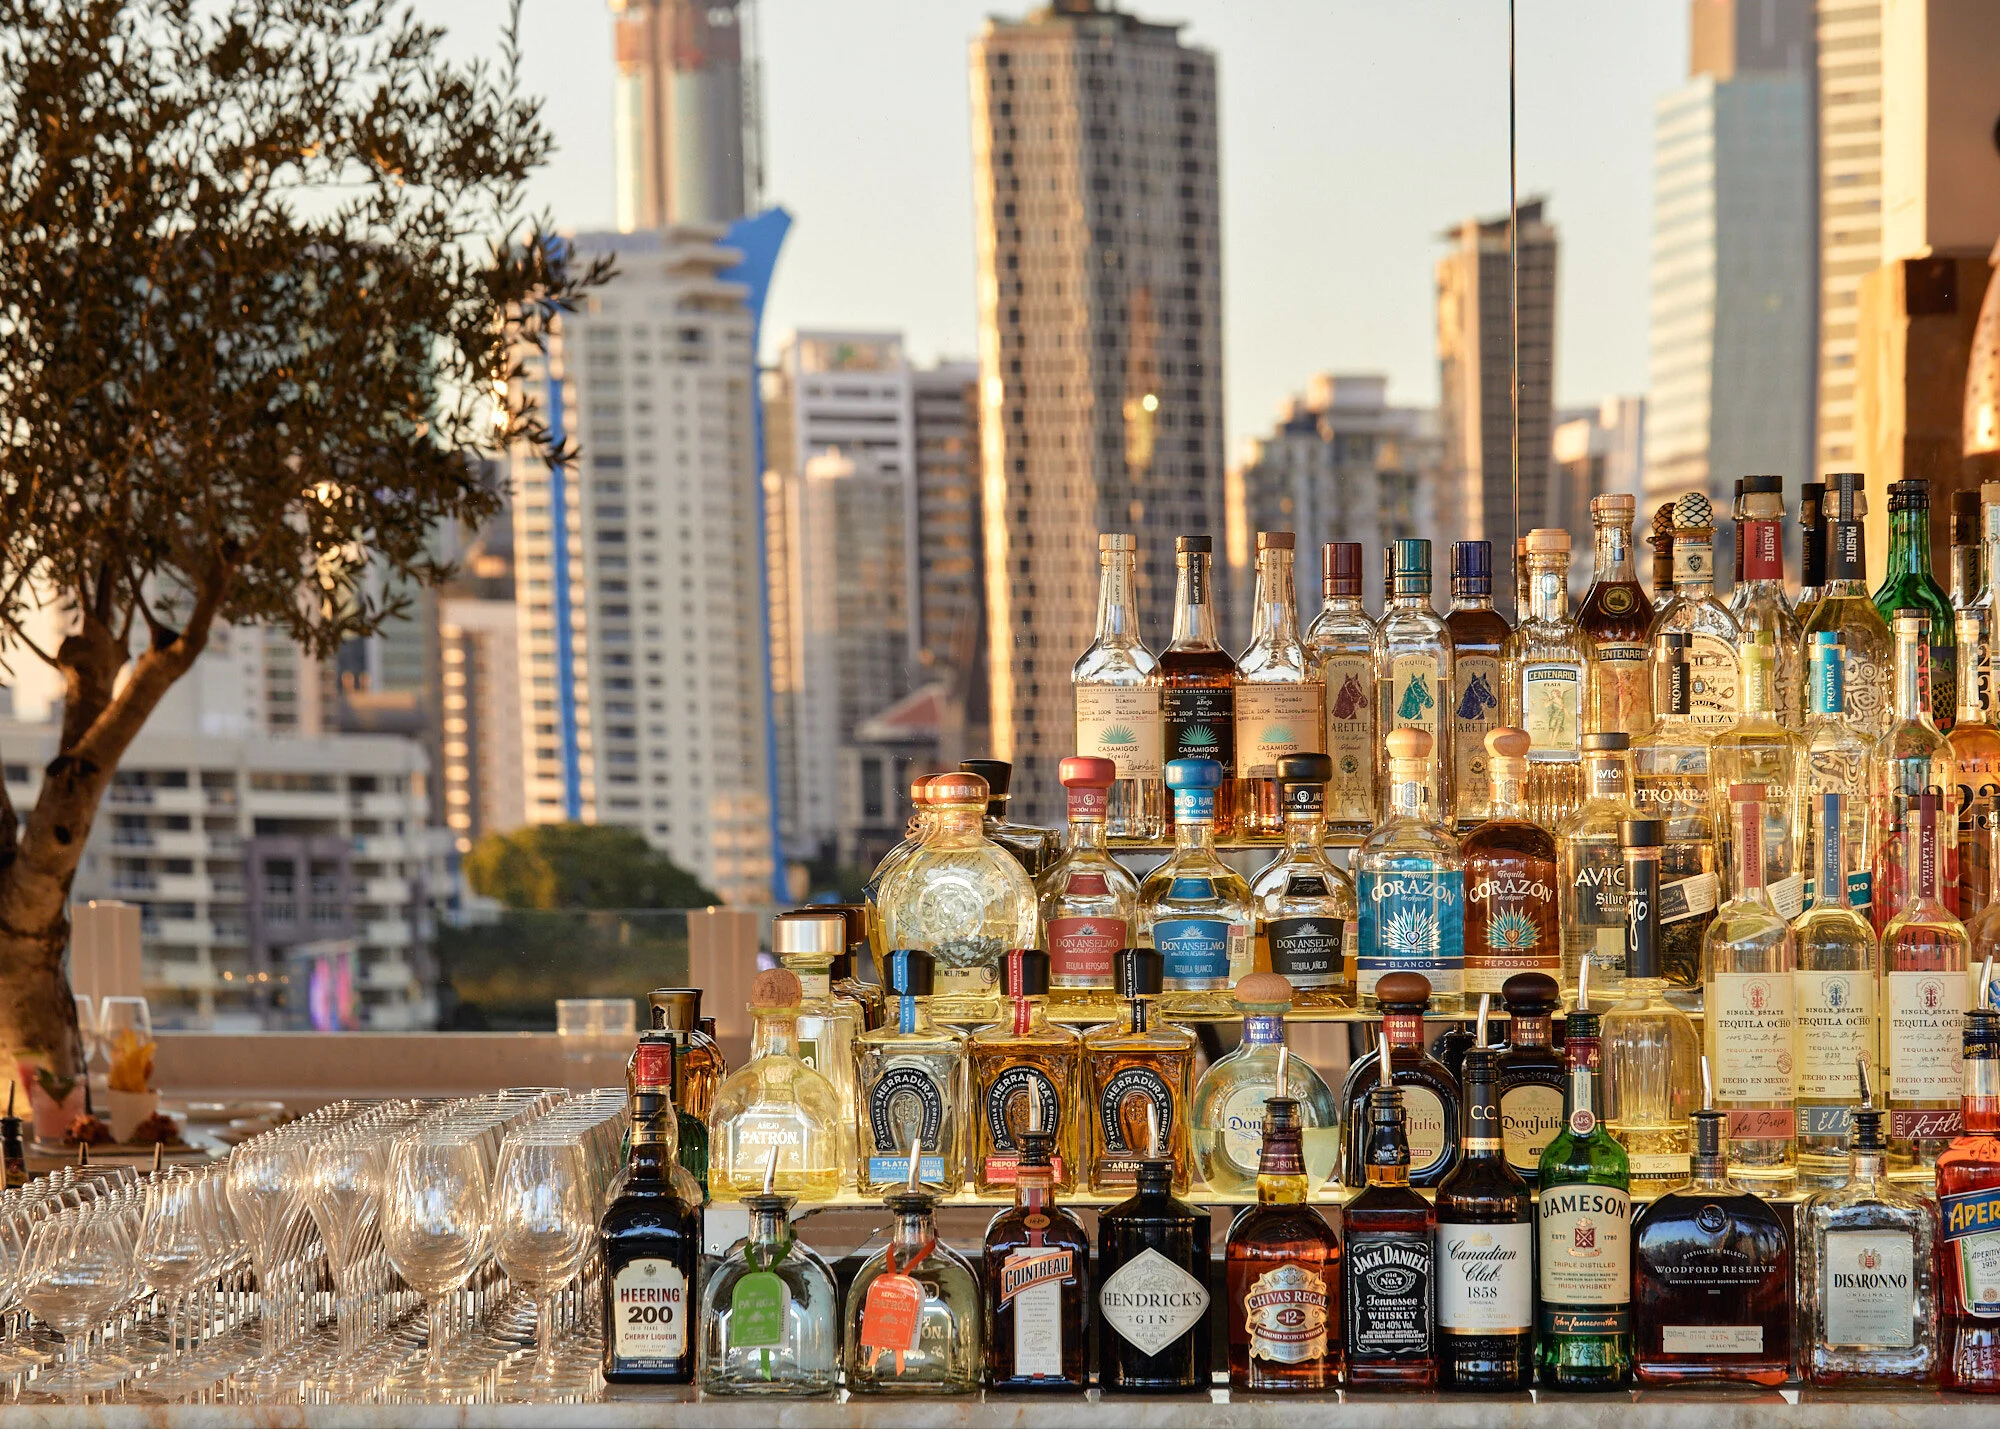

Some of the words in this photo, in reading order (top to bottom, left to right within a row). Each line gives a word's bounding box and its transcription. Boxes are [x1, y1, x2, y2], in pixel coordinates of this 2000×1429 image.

[1765, 527, 1774, 561] PASOTE
[1846, 527, 1856, 562] PASOTE
[1333, 660, 1365, 668] TEQUILA
[1400, 660, 1432, 668] TEQUILA
[1460, 660, 1494, 668] TEQUILA
[1529, 671, 1575, 680] CENTENARIO
[1672, 666, 1681, 711] TROMBA
[1331, 723, 1367, 732] ARETTE
[1458, 723, 1497, 733] ARETTE
[1597, 767, 1624, 778] AVIÓN
[1638, 789, 1709, 803] TROMBA
[1922, 847, 1930, 888] LATILLA
[1401, 870, 1430, 879] Tequila
[1497, 870, 1526, 879] Tequila
[1371, 876, 1455, 906] CORAZÓN
[1469, 877, 1554, 903] CORAZÓN
[1056, 939, 1077, 947] DON
[1079, 939, 1118, 948] ANSELMO
[1162, 941, 1180, 950] DON
[1182, 941, 1224, 950] ANSELMO
[1277, 940, 1296, 948] DON
[1298, 938, 1339, 948] ANSELMO
[1066, 961, 1084, 970] TEQUILA
[1085, 961, 1109, 971] REPOSADO
[1175, 965, 1193, 973] TEQUILA
[1195, 965, 1212, 974] BLANCO
[1291, 961, 1309, 970] TEQUILA
[1310, 961, 1327, 971] AÑEJO
[1518, 1021, 1540, 1029] AÑEJO
[1719, 1020, 1764, 1028] TEQUILA
[1767, 1020, 1791, 1028] OCHO
[1798, 1018, 1843, 1026] TEQUILA
[1846, 1018, 1870, 1026] OCHO
[1893, 1020, 1939, 1028] TEQUILA
[1964, 1043, 1987, 1055] APEROL
[876, 1074, 936, 1100] HERRADURA
[1107, 1075, 1166, 1101] HERRADURA
[1471, 1106, 1497, 1120] C.C.
[876, 1108, 886, 1139] TEQUILA
[928, 1107, 938, 1138] ORIGINAL
[992, 1108, 1003, 1139] TEQUILA
[1107, 1109, 1116, 1140] TEQUILA
[1228, 1116, 1261, 1131] Don
[1896, 1114, 1904, 1136] 2015
[1277, 1161, 1292, 1169] 1801
[1543, 1194, 1627, 1219] JAMESON
[1448, 1240, 1517, 1261] Canadian
[1353, 1250, 1384, 1275] JACK
[1384, 1245, 1430, 1274] DANIEL'S
[1982, 1261, 1997, 1269] 1919
[1005, 1256, 1070, 1293] COINTREAU
[1655, 1265, 1718, 1273] WOODFORD
[1723, 1265, 1776, 1273] RESERVE
[1380, 1277, 1402, 1286] No.7
[1834, 1273, 1907, 1289] DISARONNO
[620, 1287, 680, 1302] HEERING
[1467, 1286, 1498, 1298] 1858
[1104, 1291, 1202, 1307] HENDRICK'S
[1250, 1291, 1291, 1308] CHIVAS
[1294, 1291, 1327, 1307] REGAL
[1366, 1294, 1418, 1307] Tennessee
[628, 1306, 673, 1323] 200
[1136, 1315, 1167, 1324] GIN
[1284, 1310, 1297, 1323] 12
[1368, 1311, 1417, 1320] WHISKEY
[1371, 1321, 1385, 1330] 70cl
[1386, 1321, 1401, 1330] 40%
[1257, 1328, 1282, 1339] BLENDED
